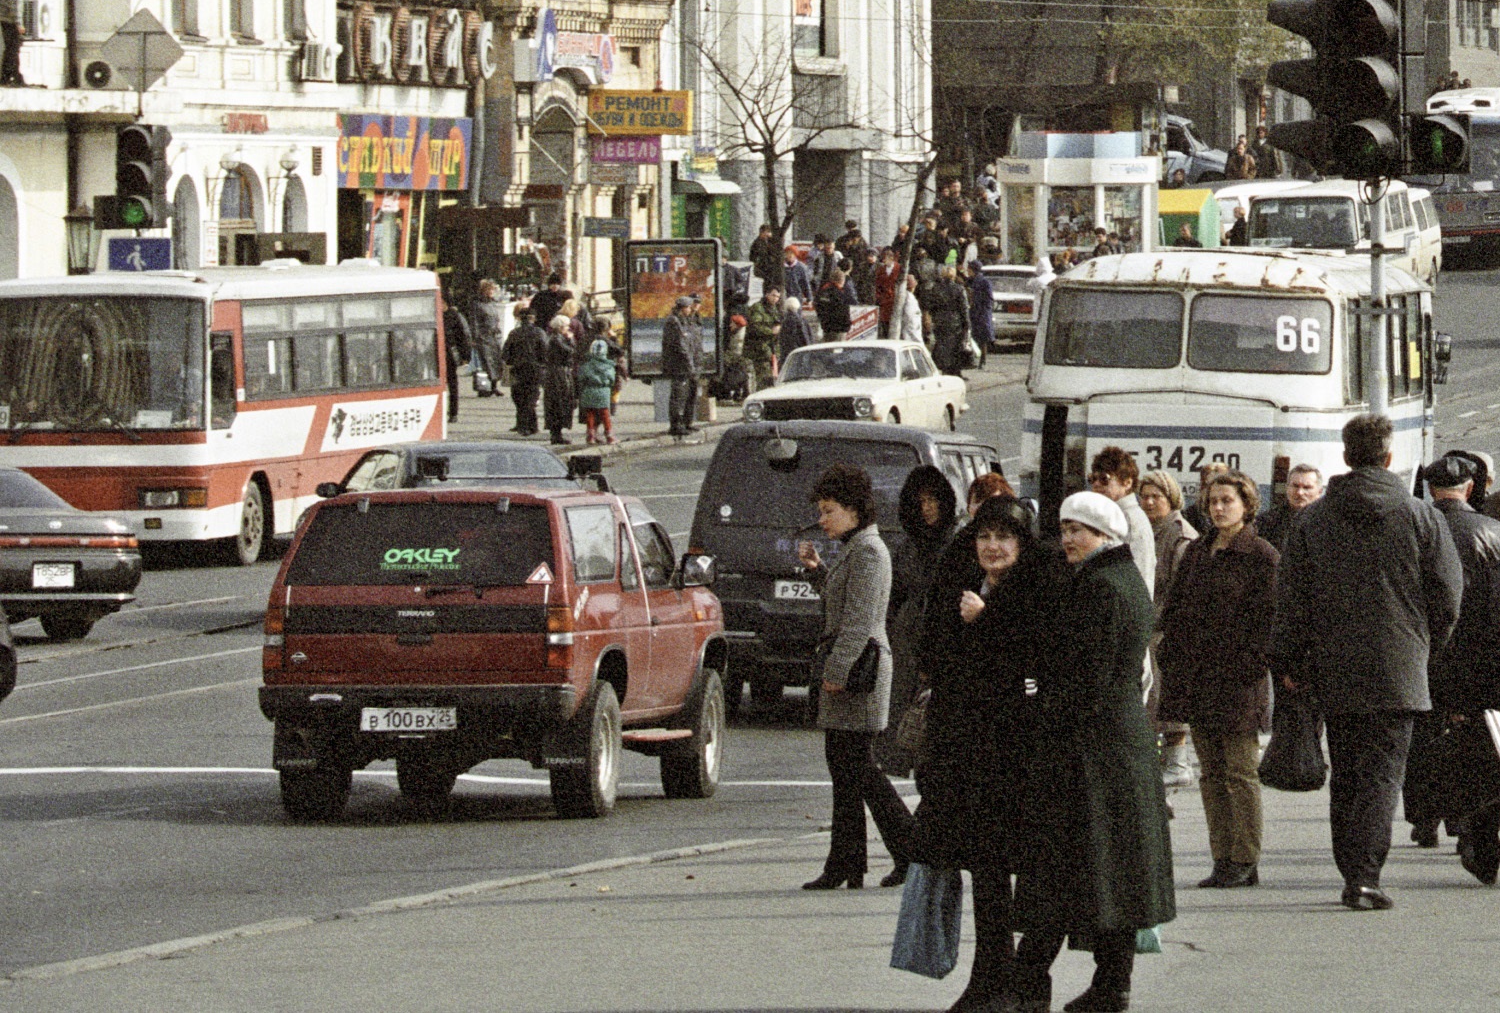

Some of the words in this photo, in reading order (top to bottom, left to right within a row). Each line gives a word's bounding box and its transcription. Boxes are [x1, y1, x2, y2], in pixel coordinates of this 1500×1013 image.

[605, 96, 671, 111] РЕМОНТ
[428, 138, 461, 175] МИР
[1276, 315, 1321, 355] 66
[1146, 445, 1206, 473] 342
[384, 548, 461, 563] OAKLEY
[383, 712, 413, 728] 100
